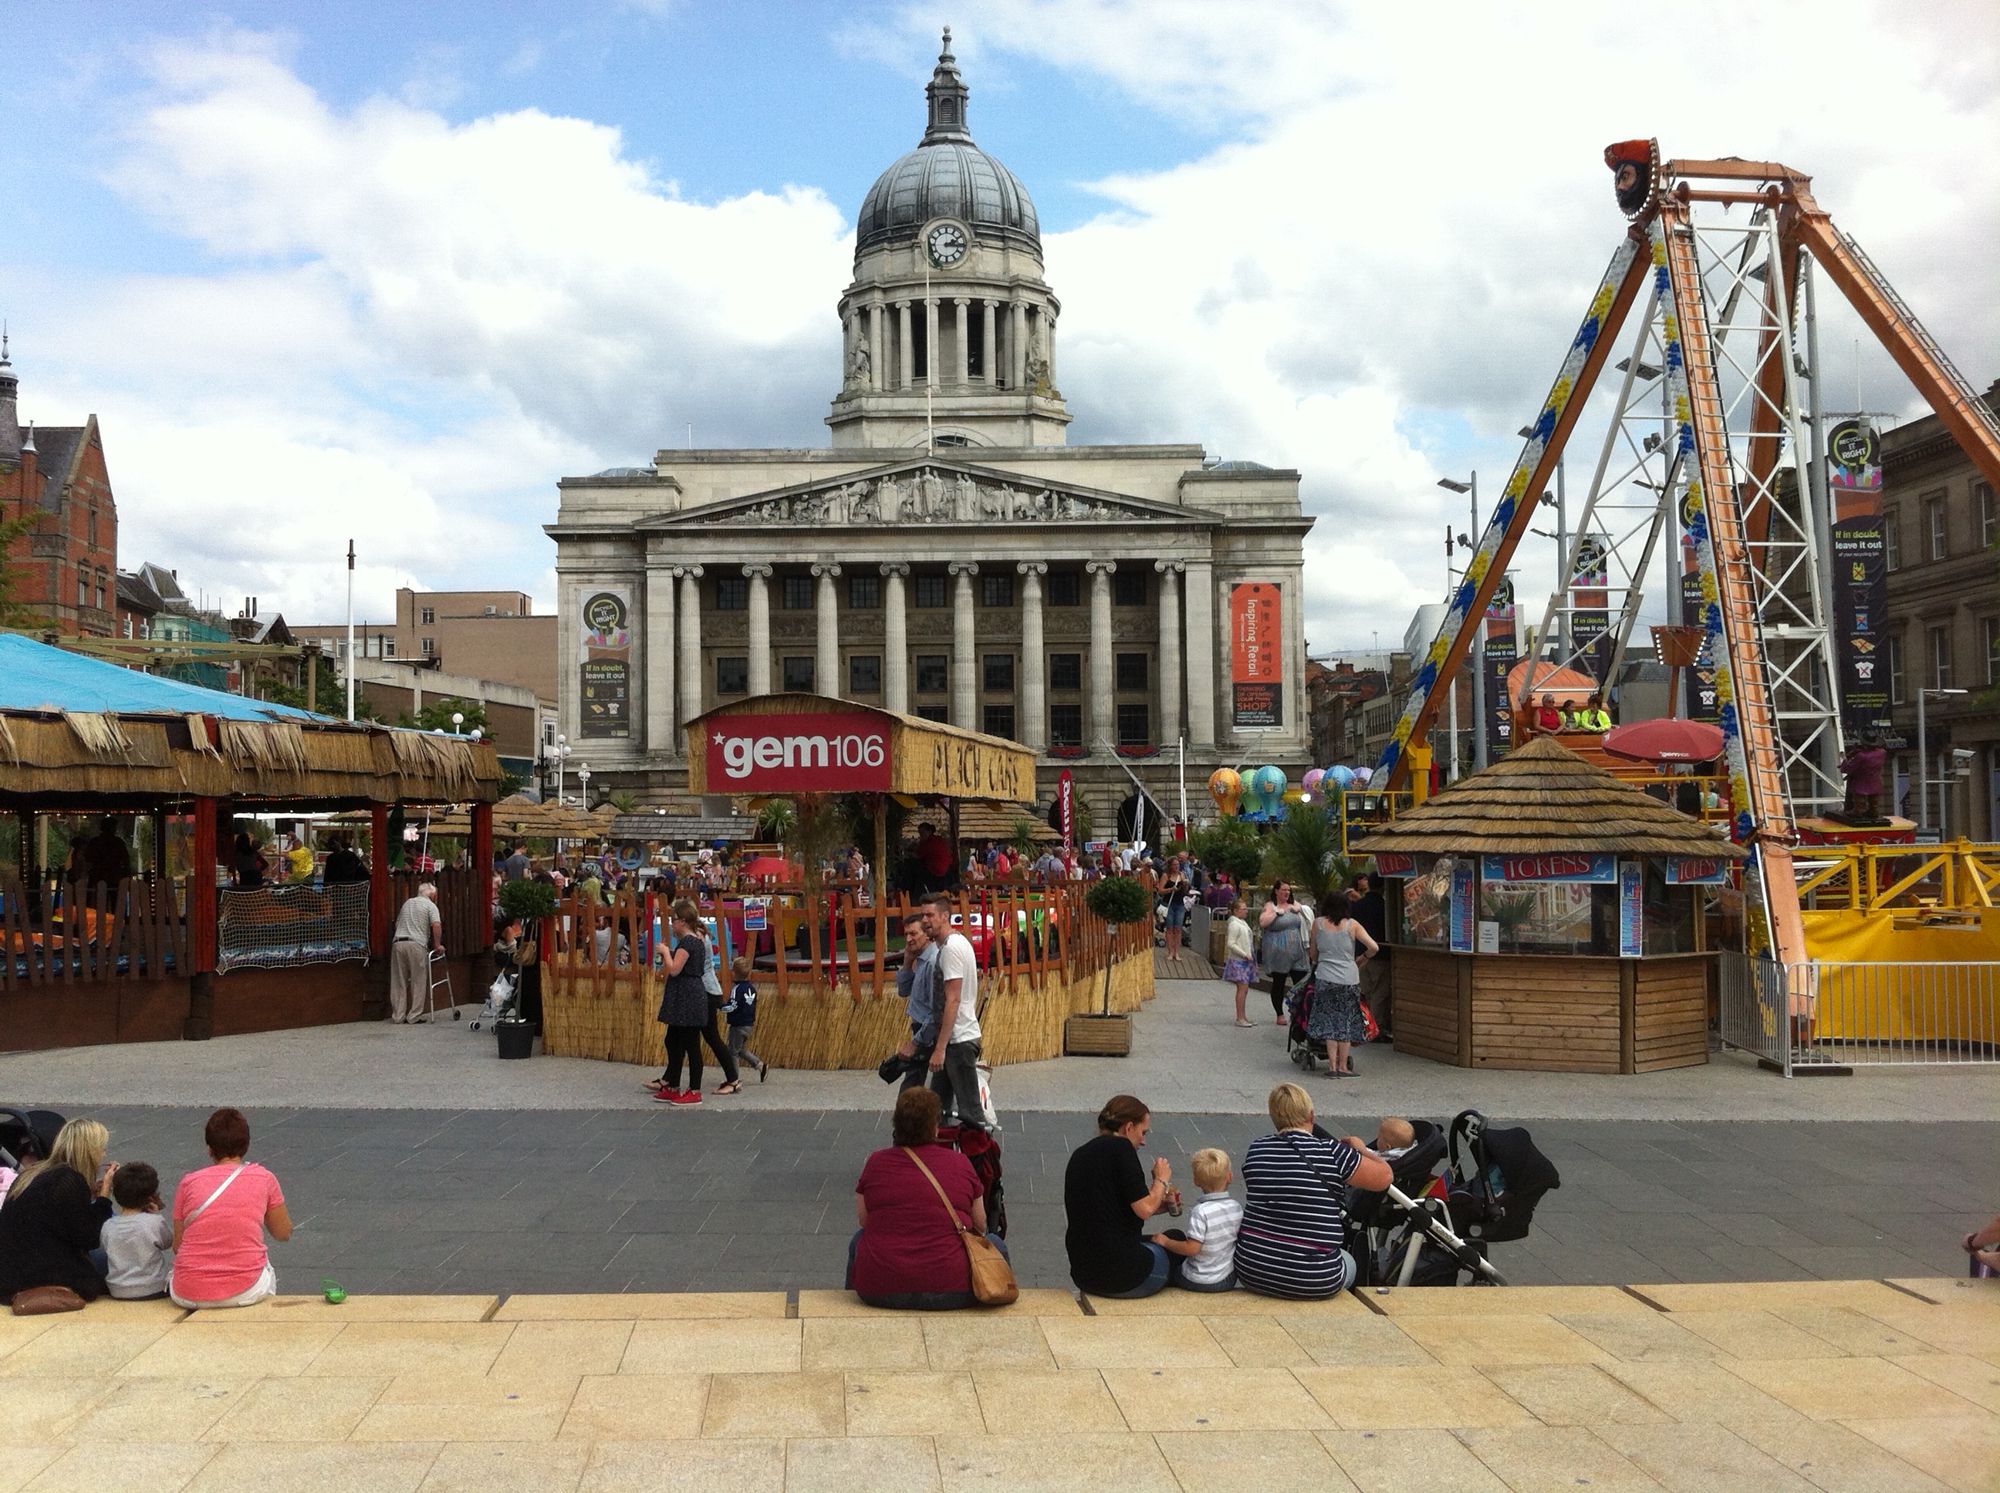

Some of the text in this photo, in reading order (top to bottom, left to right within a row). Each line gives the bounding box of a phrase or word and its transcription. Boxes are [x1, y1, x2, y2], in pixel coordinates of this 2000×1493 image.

[1839, 437, 1864, 445] RECYCL
[1848, 442, 1857, 450] IT
[1842, 447, 1867, 459] RIGHT
[1843, 531, 1851, 539] in
[1835, 541, 1883, 549] leave it out
[1245, 599, 1260, 676] Inspiring Retail
[1236, 702, 1273, 711] SHOP?
[1504, 855, 1591, 878] TOKENS
